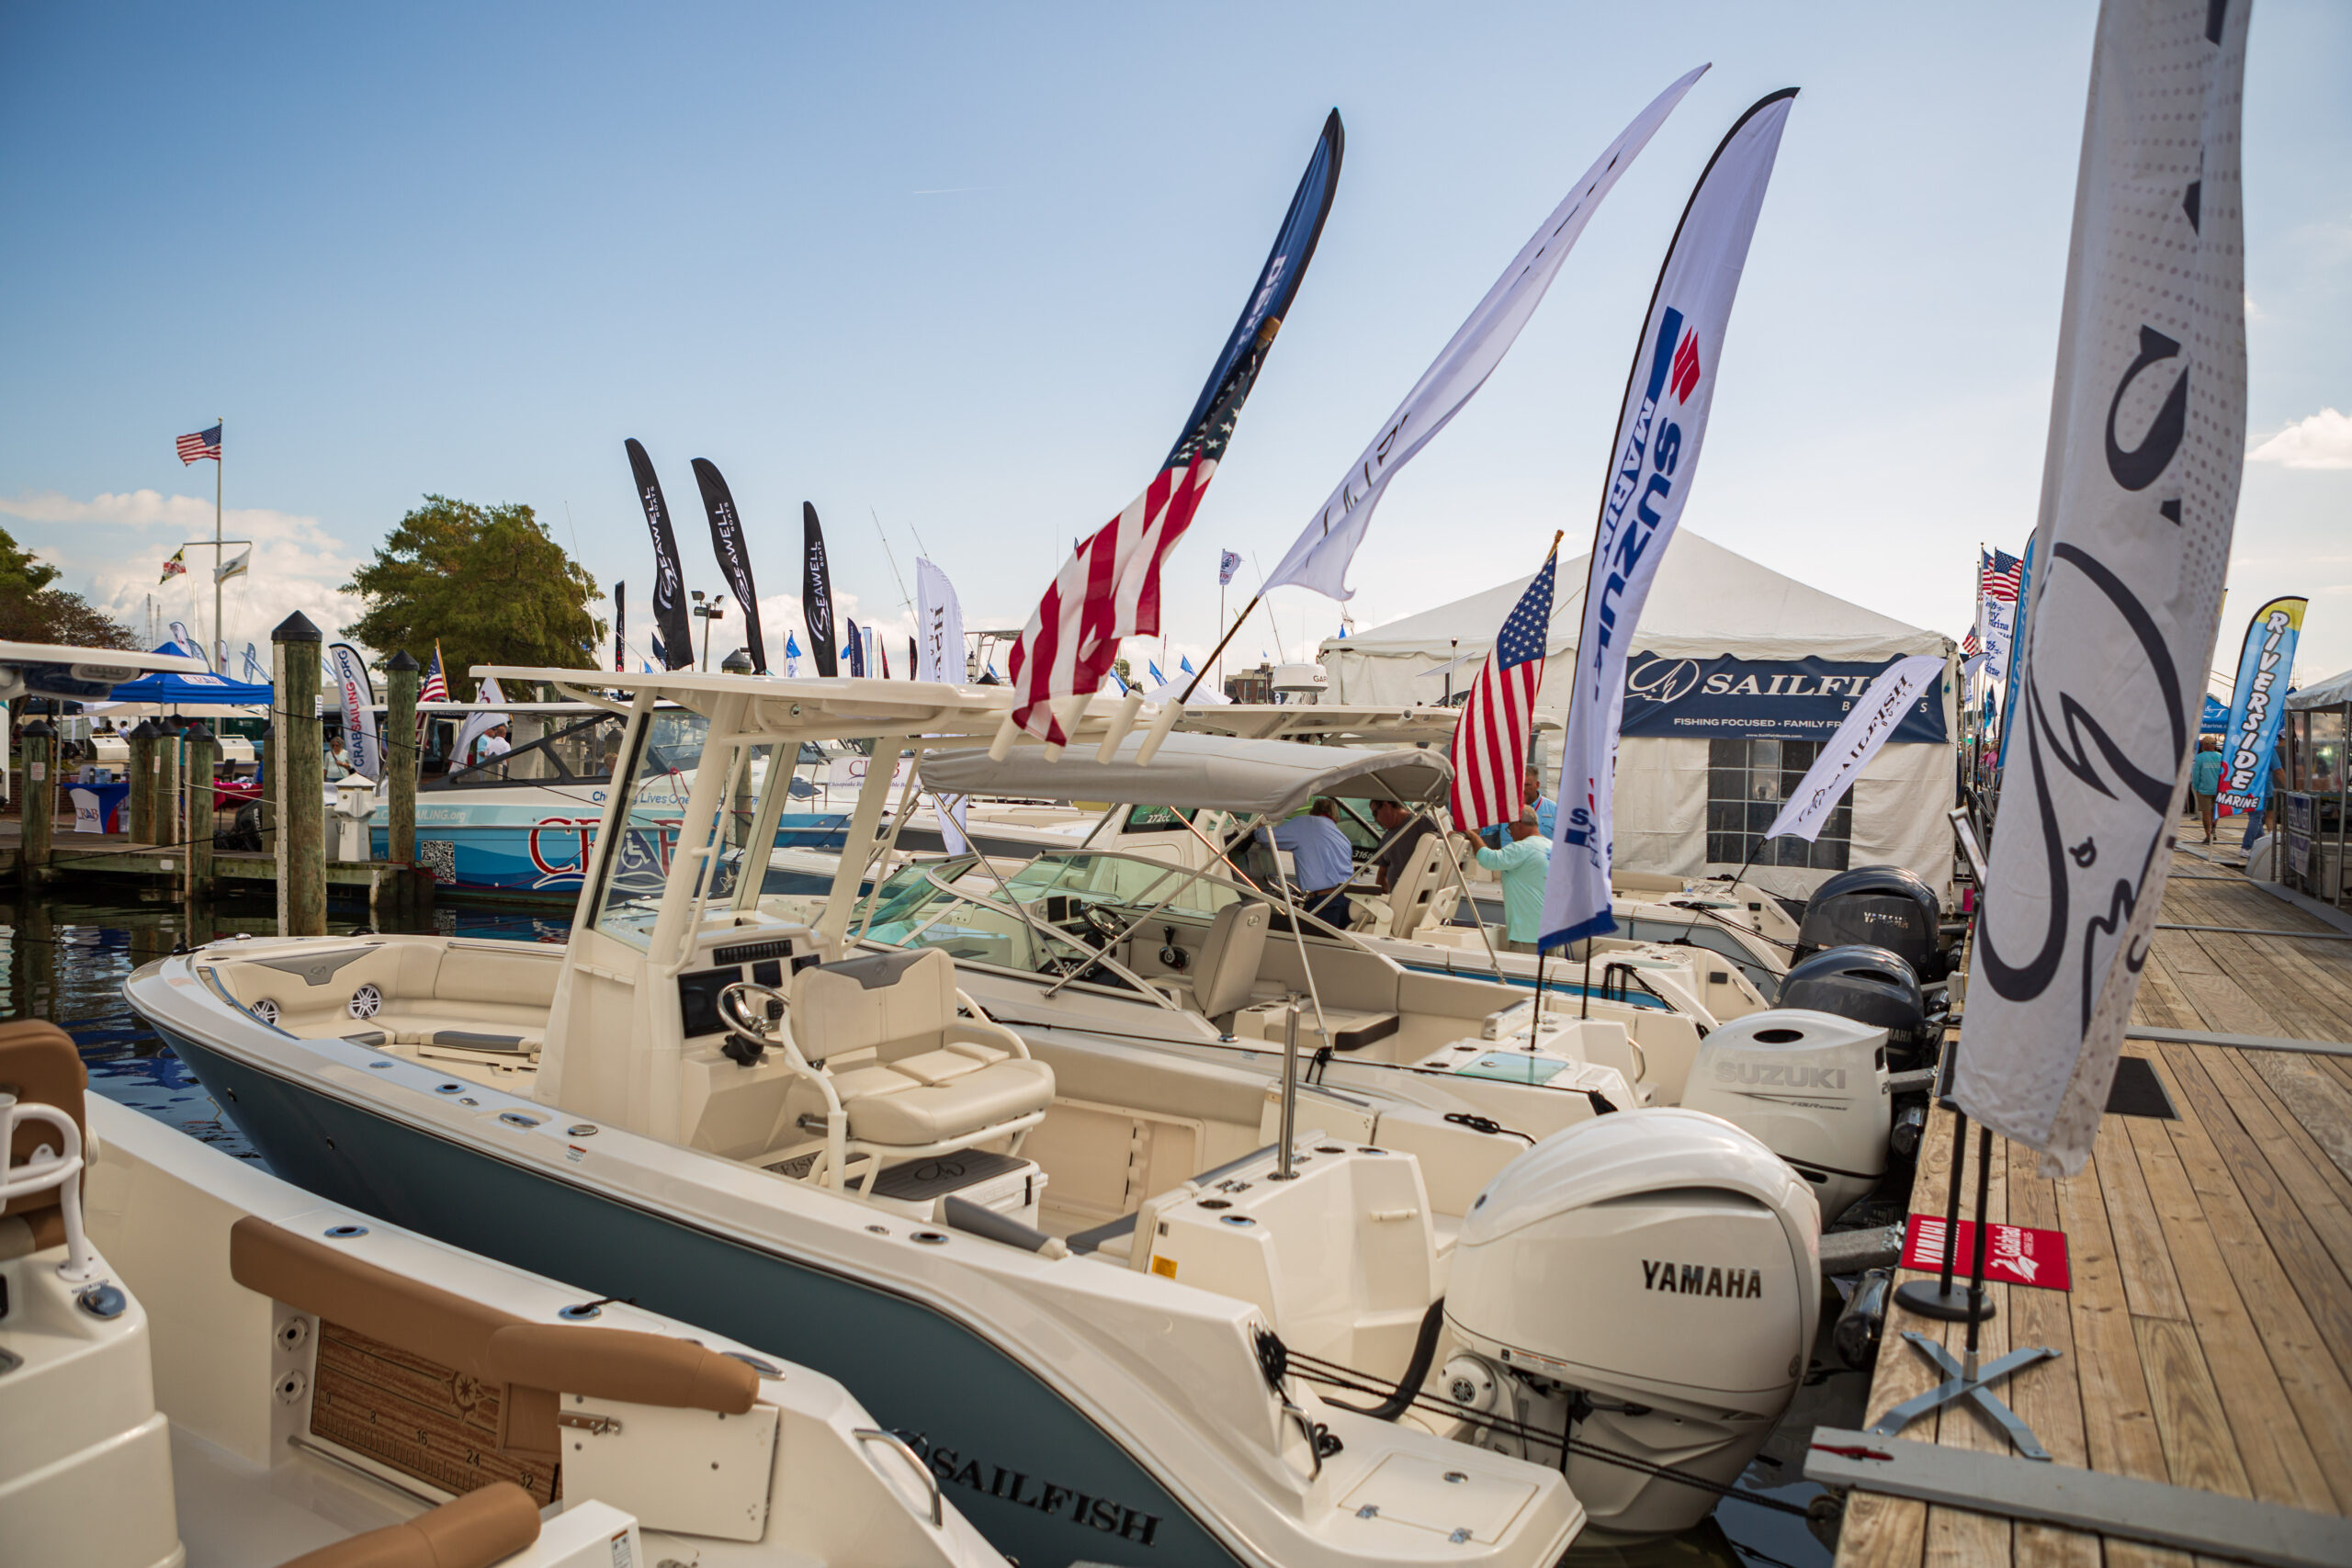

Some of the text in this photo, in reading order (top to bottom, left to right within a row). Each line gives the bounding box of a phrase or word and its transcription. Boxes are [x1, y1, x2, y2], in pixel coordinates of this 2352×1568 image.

[650, 485, 661, 518] BOATS
[724, 502, 735, 532] BOATS
[645, 487, 677, 604] SEAWELL
[1594, 417, 1682, 701] SUZU
[808, 541, 829, 640] SEAWELL
[1702, 673, 1928, 698] SAILFI
[2231, 611, 2290, 791] RIVERSIDE
[1674, 717, 1719, 727] FISHING
[1721, 718, 1775, 728] FOCUSED
[1783, 719, 1825, 728] FAMILY
[639, 792, 690, 805] Lives One
[2216, 793, 2258, 808] MARINE
[1863, 911, 1909, 930] YAMAHA
[1714, 1061, 1846, 1089] SUZUKI
[1913, 1219, 1948, 1265] YAMAHA
[1642, 1258, 1762, 1299] YAMAHA
[369, 1410, 377, 1424] 8
[416, 1429, 428, 1446] 16
[466, 1450, 481, 1467] 24
[520, 1472, 535, 1490] 32
[932, 1445, 1164, 1548] SAILFISH
